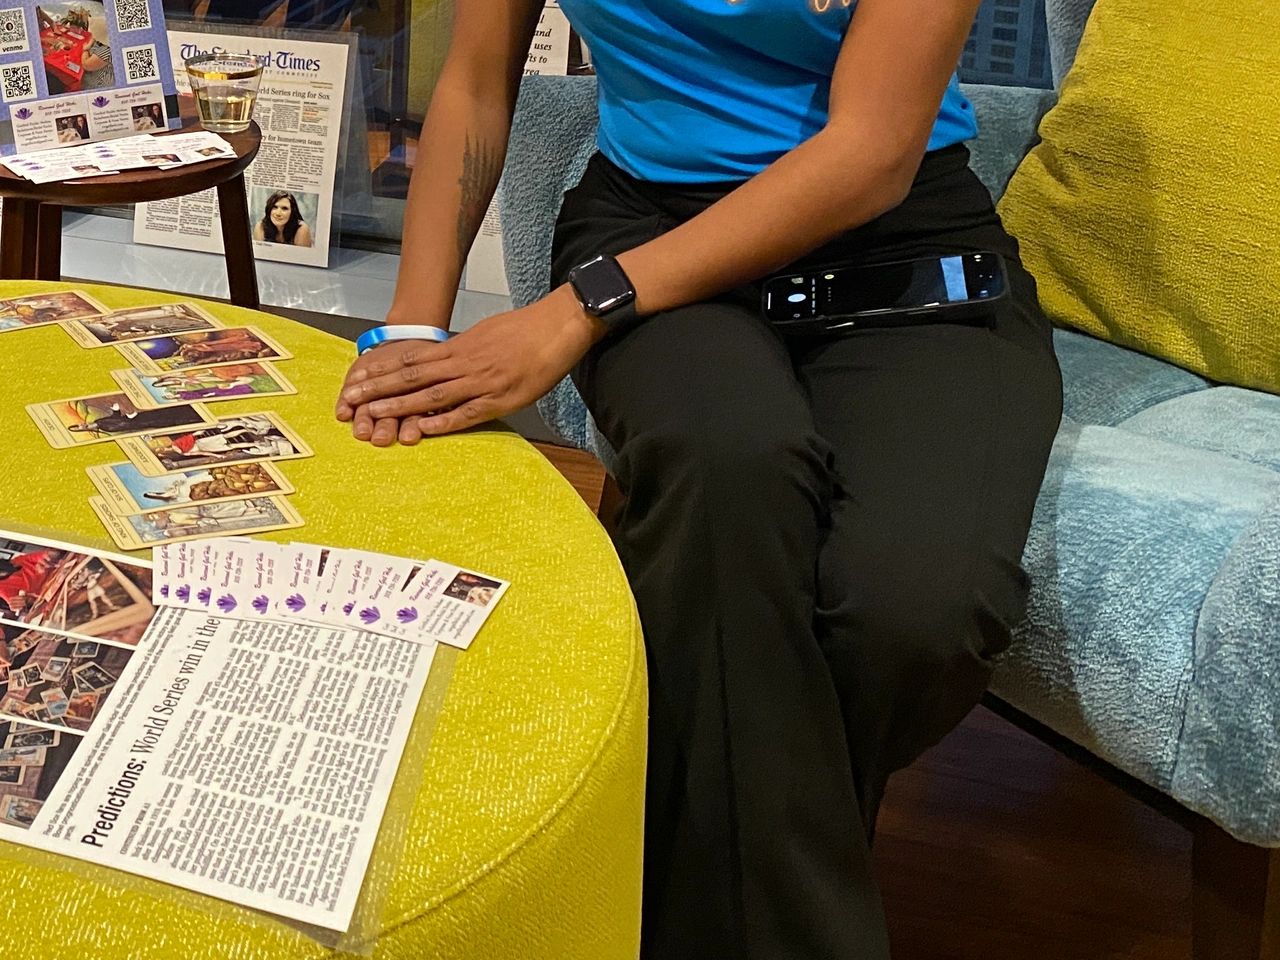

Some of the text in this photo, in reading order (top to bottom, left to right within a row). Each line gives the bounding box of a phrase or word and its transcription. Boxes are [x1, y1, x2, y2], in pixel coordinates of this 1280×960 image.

[539, 55, 547, 63] to
[271, 88, 291, 96] Series
[292, 89, 306, 99] ring
[82, 619, 220, 847] Predictions: World Series win in the
